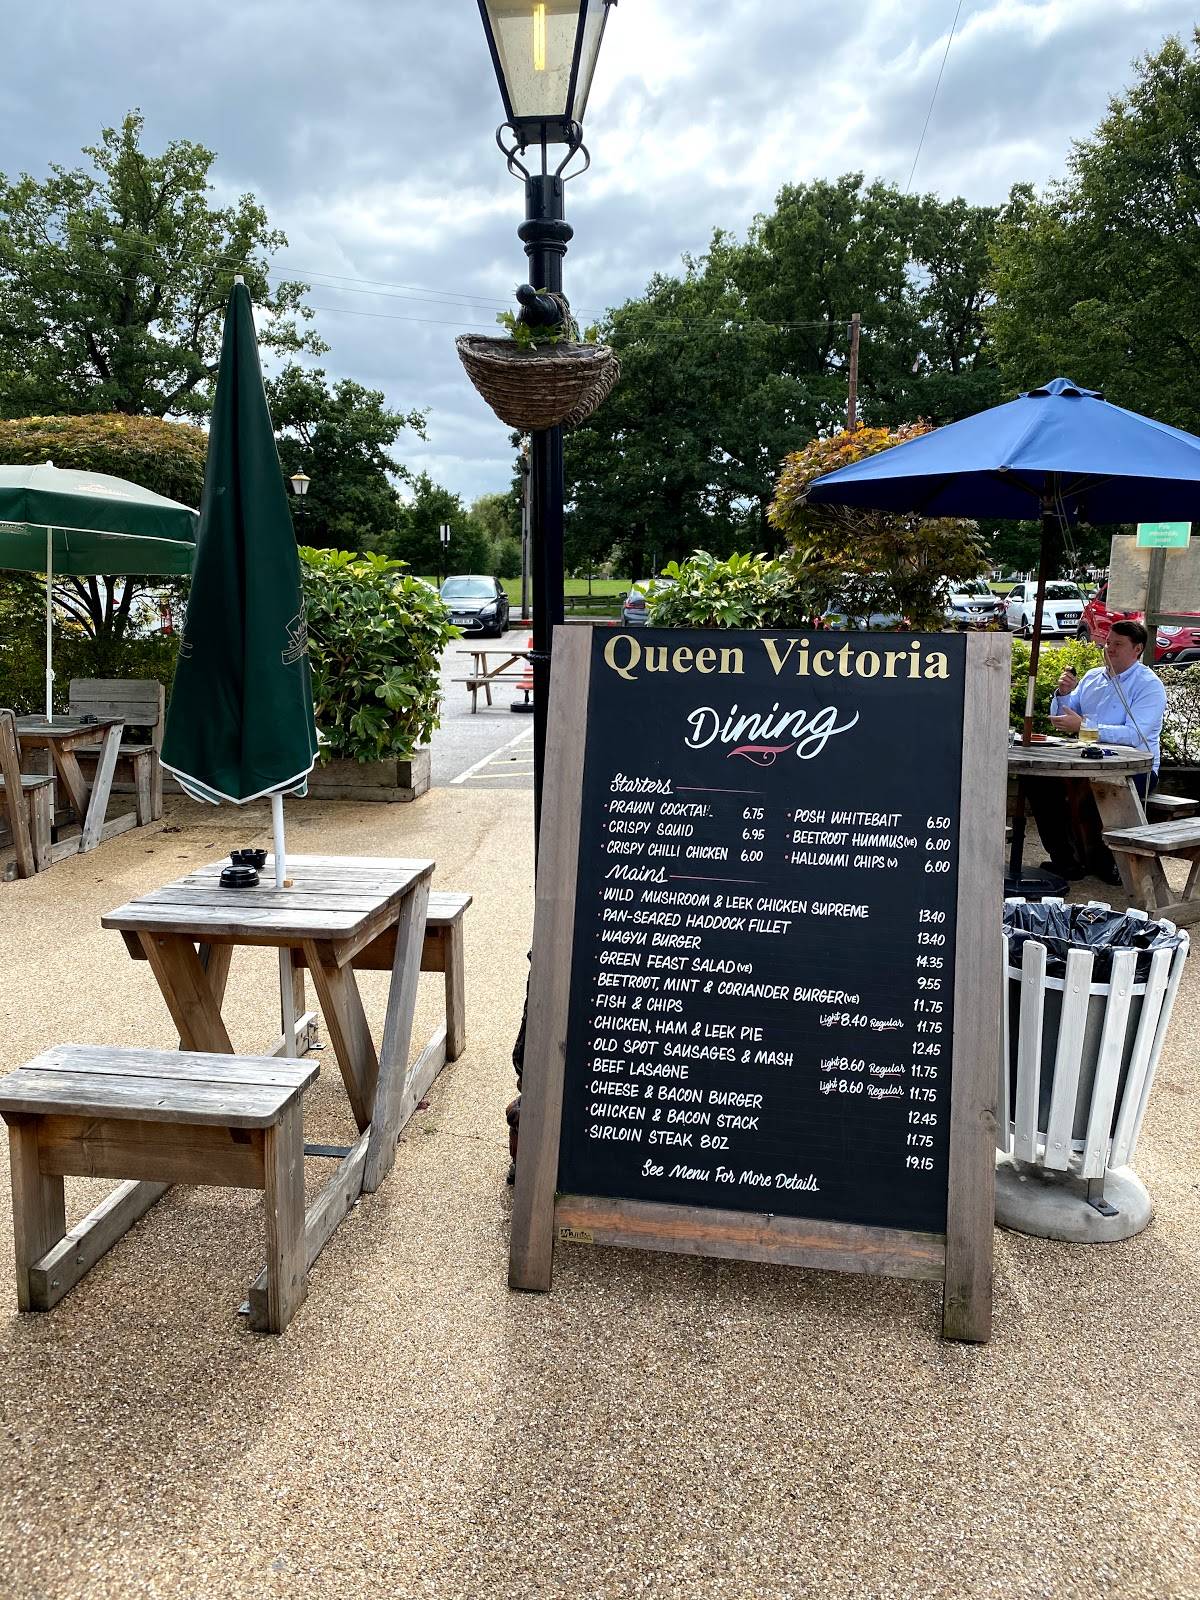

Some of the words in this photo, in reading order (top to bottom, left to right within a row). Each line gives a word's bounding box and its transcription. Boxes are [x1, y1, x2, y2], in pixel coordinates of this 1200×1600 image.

[604, 635, 745, 680] Queen
[760, 638, 950, 679] Victoria
[684, 702, 859, 760] Dining
[610, 773, 674, 795] Starters
[609, 800, 655, 814] PRAWN
[743, 807, 764, 820] 6.75
[794, 809, 825, 823] POSH
[831, 811, 902, 827] WHITEBAIT
[927, 816, 950, 829] 6.50
[609, 820, 651, 834] CRISPY
[656, 823, 693, 837] SQUID
[742, 828, 765, 840] 6.95
[792, 830, 849, 845] BEETROOT
[925, 838, 951, 851] 6.00
[607, 840, 645, 855] CRISPY
[648, 843, 680, 857] CHILLI
[686, 846, 728, 860] CHICKEN
[740, 849, 763, 862] 6.00
[791, 851, 849, 867] HALLOUMI
[924, 860, 950, 873] 6.00
[604, 864, 668, 883] Mains
[604, 887, 634, 901] WILD
[640, 890, 710, 906] MUSHROOM
[713, 895, 723, 908] &
[726, 896, 754, 910] LEEK
[756, 898, 807, 914] CHICKEN
[811, 901, 869, 918] SUPREME
[919, 909, 945, 923] 13.40
[603, 908, 681, 927] PAN-SEARED
[686, 914, 746, 931] HADDOCK
[748, 918, 792, 934] FILLET
[917, 932, 945, 946] 13.40
[602, 929, 647, 945] WAGYU
[652, 932, 702, 950] BURGER
[916, 955, 944, 969] 14.35
[600, 951, 641, 966] GREEN
[647, 954, 689, 970] FEAST
[917, 977, 942, 990] 9.55
[598, 972, 660, 991] BEETROOT,
[663, 978, 700, 992] MINT
[703, 980, 713, 994] &
[718, 981, 790, 1000] CORIANDER
[914, 998, 943, 1013] 11.75
[596, 994, 626, 1008] FISH
[631, 996, 642, 1010] &
[647, 997, 683, 1012] CHIPS
[819, 1011, 840, 1028] Light
[840, 1013, 868, 1027] 8.40
[870, 1018, 904, 1031] Regular
[917, 1020, 942, 1033] 11.75
[594, 1015, 651, 1034] CHICKEN,
[655, 1020, 687, 1035] HAM
[691, 1022, 701, 1036] &
[705, 1024, 736, 1039] LEEK
[740, 1026, 763, 1042] PIE
[912, 1041, 941, 1056] 12.45
[593, 1038, 618, 1052] OLD
[623, 1039, 659, 1055] SPOT
[663, 1042, 736, 1061] SAUSAGES
[741, 1050, 751, 1063] &
[754, 1050, 793, 1067] MASH
[820, 1056, 840, 1073] Light
[839, 1057, 865, 1072] 8.60
[868, 1063, 906, 1078] Regular
[911, 1064, 938, 1079] 11.75
[593, 1058, 625, 1073] BEEF
[630, 1062, 689, 1079] LASAGNE
[819, 1077, 838, 1095] Light
[839, 1079, 863, 1094] 8.60
[867, 1084, 904, 1100] Regular
[910, 1086, 937, 1102] 11.75
[591, 1080, 639, 1097] CHEESE
[644, 1085, 654, 1098] &
[658, 1086, 703, 1103] BACON
[708, 1090, 763, 1109] BURGER
[908, 1110, 937, 1125] 12.45
[590, 1103, 646, 1120] CHICKEN
[652, 1108, 661, 1121] &
[667, 1109, 711, 1125] BACON
[717, 1114, 759, 1130] STACK
[907, 1133, 933, 1147] 11.75
[589, 1124, 642, 1142] SIRLOIN
[648, 1129, 693, 1147] STEAK
[700, 1134, 729, 1149] 8OZ
[906, 1155, 934, 1170] 19.15
[641, 1159, 664, 1176] See
[668, 1164, 710, 1181] Menu
[715, 1166, 735, 1183] For
[738, 1170, 771, 1187] More
[775, 1173, 820, 1192] Details
